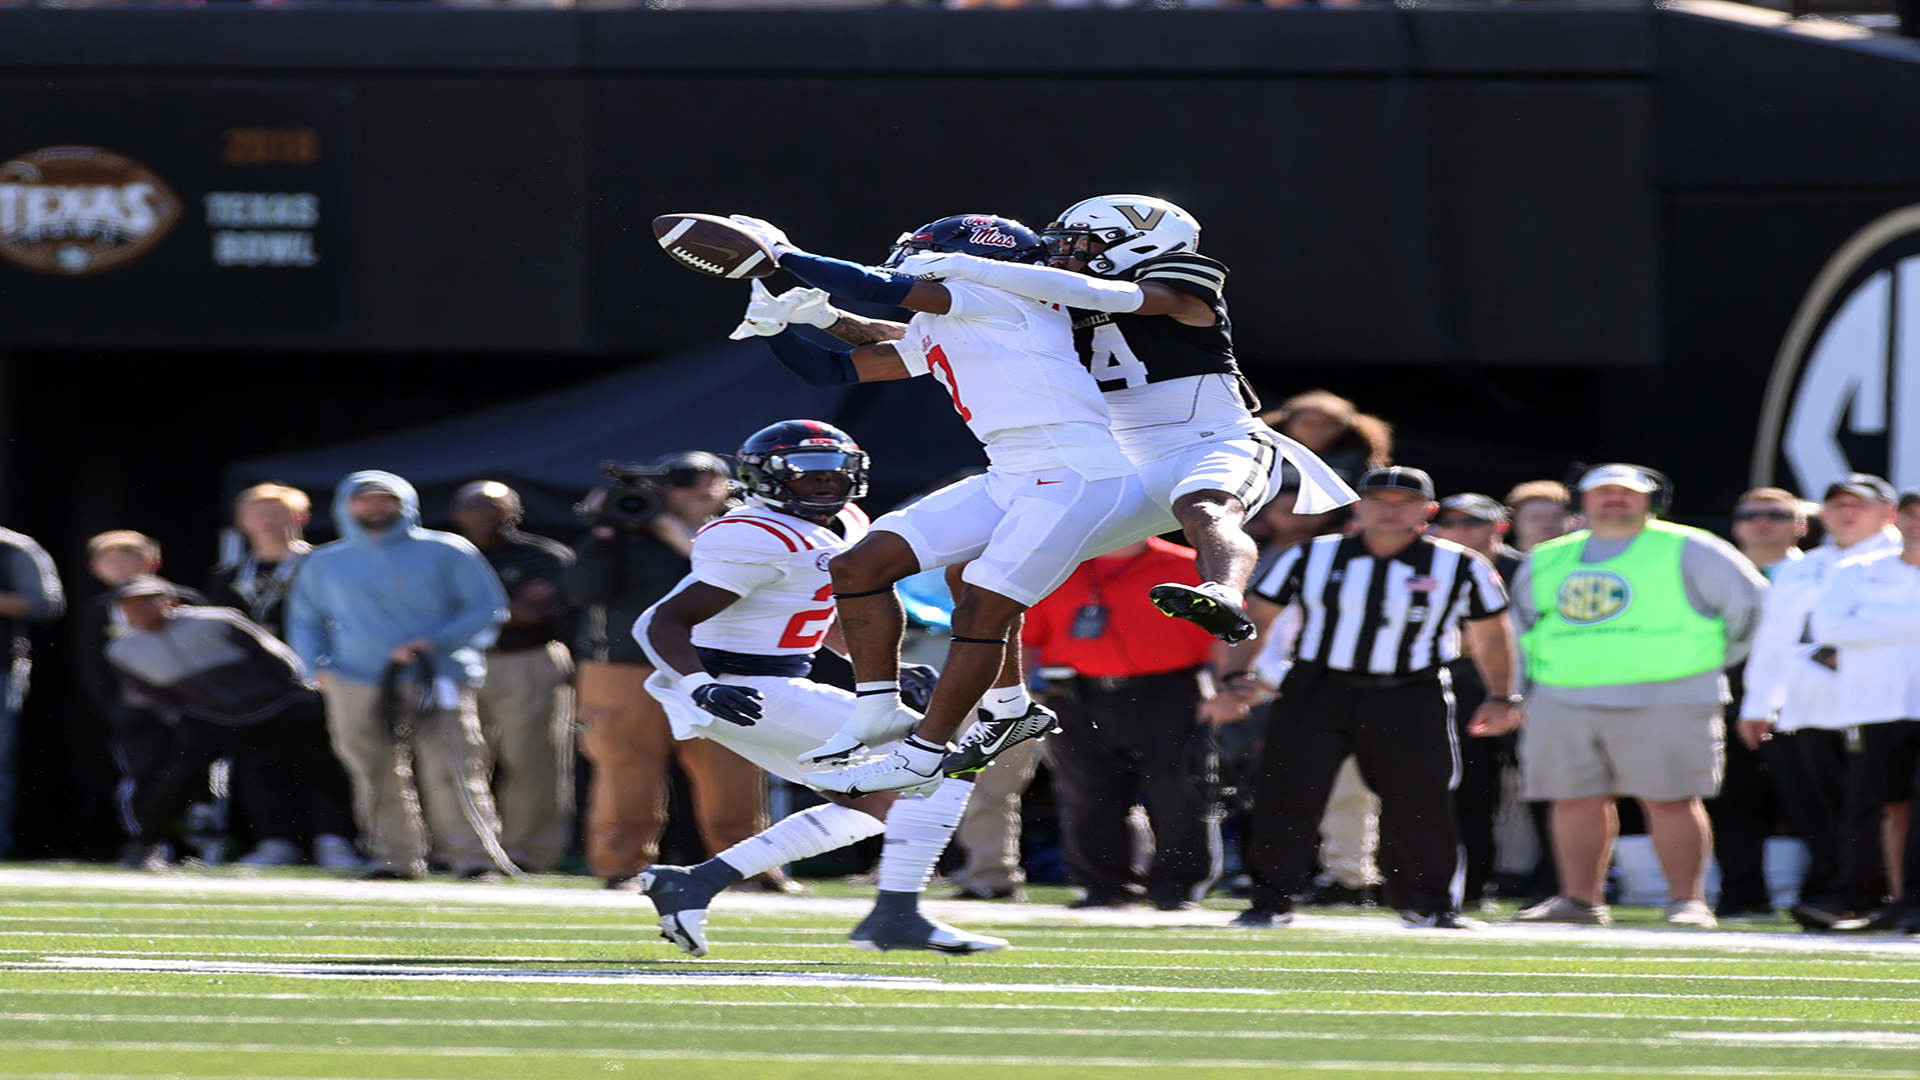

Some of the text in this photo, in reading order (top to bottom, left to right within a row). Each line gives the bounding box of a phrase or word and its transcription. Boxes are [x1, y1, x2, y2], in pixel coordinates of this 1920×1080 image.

[0, 184, 154, 234] TEXAS
[205, 193, 319, 227] TEXAS
[963, 217, 995, 227] Ole
[1110, 205, 1167, 231] V
[212, 231, 319, 266] BOWL
[970, 227, 1017, 248] Miss
[1090, 322, 1149, 388] 4
[925, 344, 972, 422] 7
[1559, 574, 1624, 620] SEC
